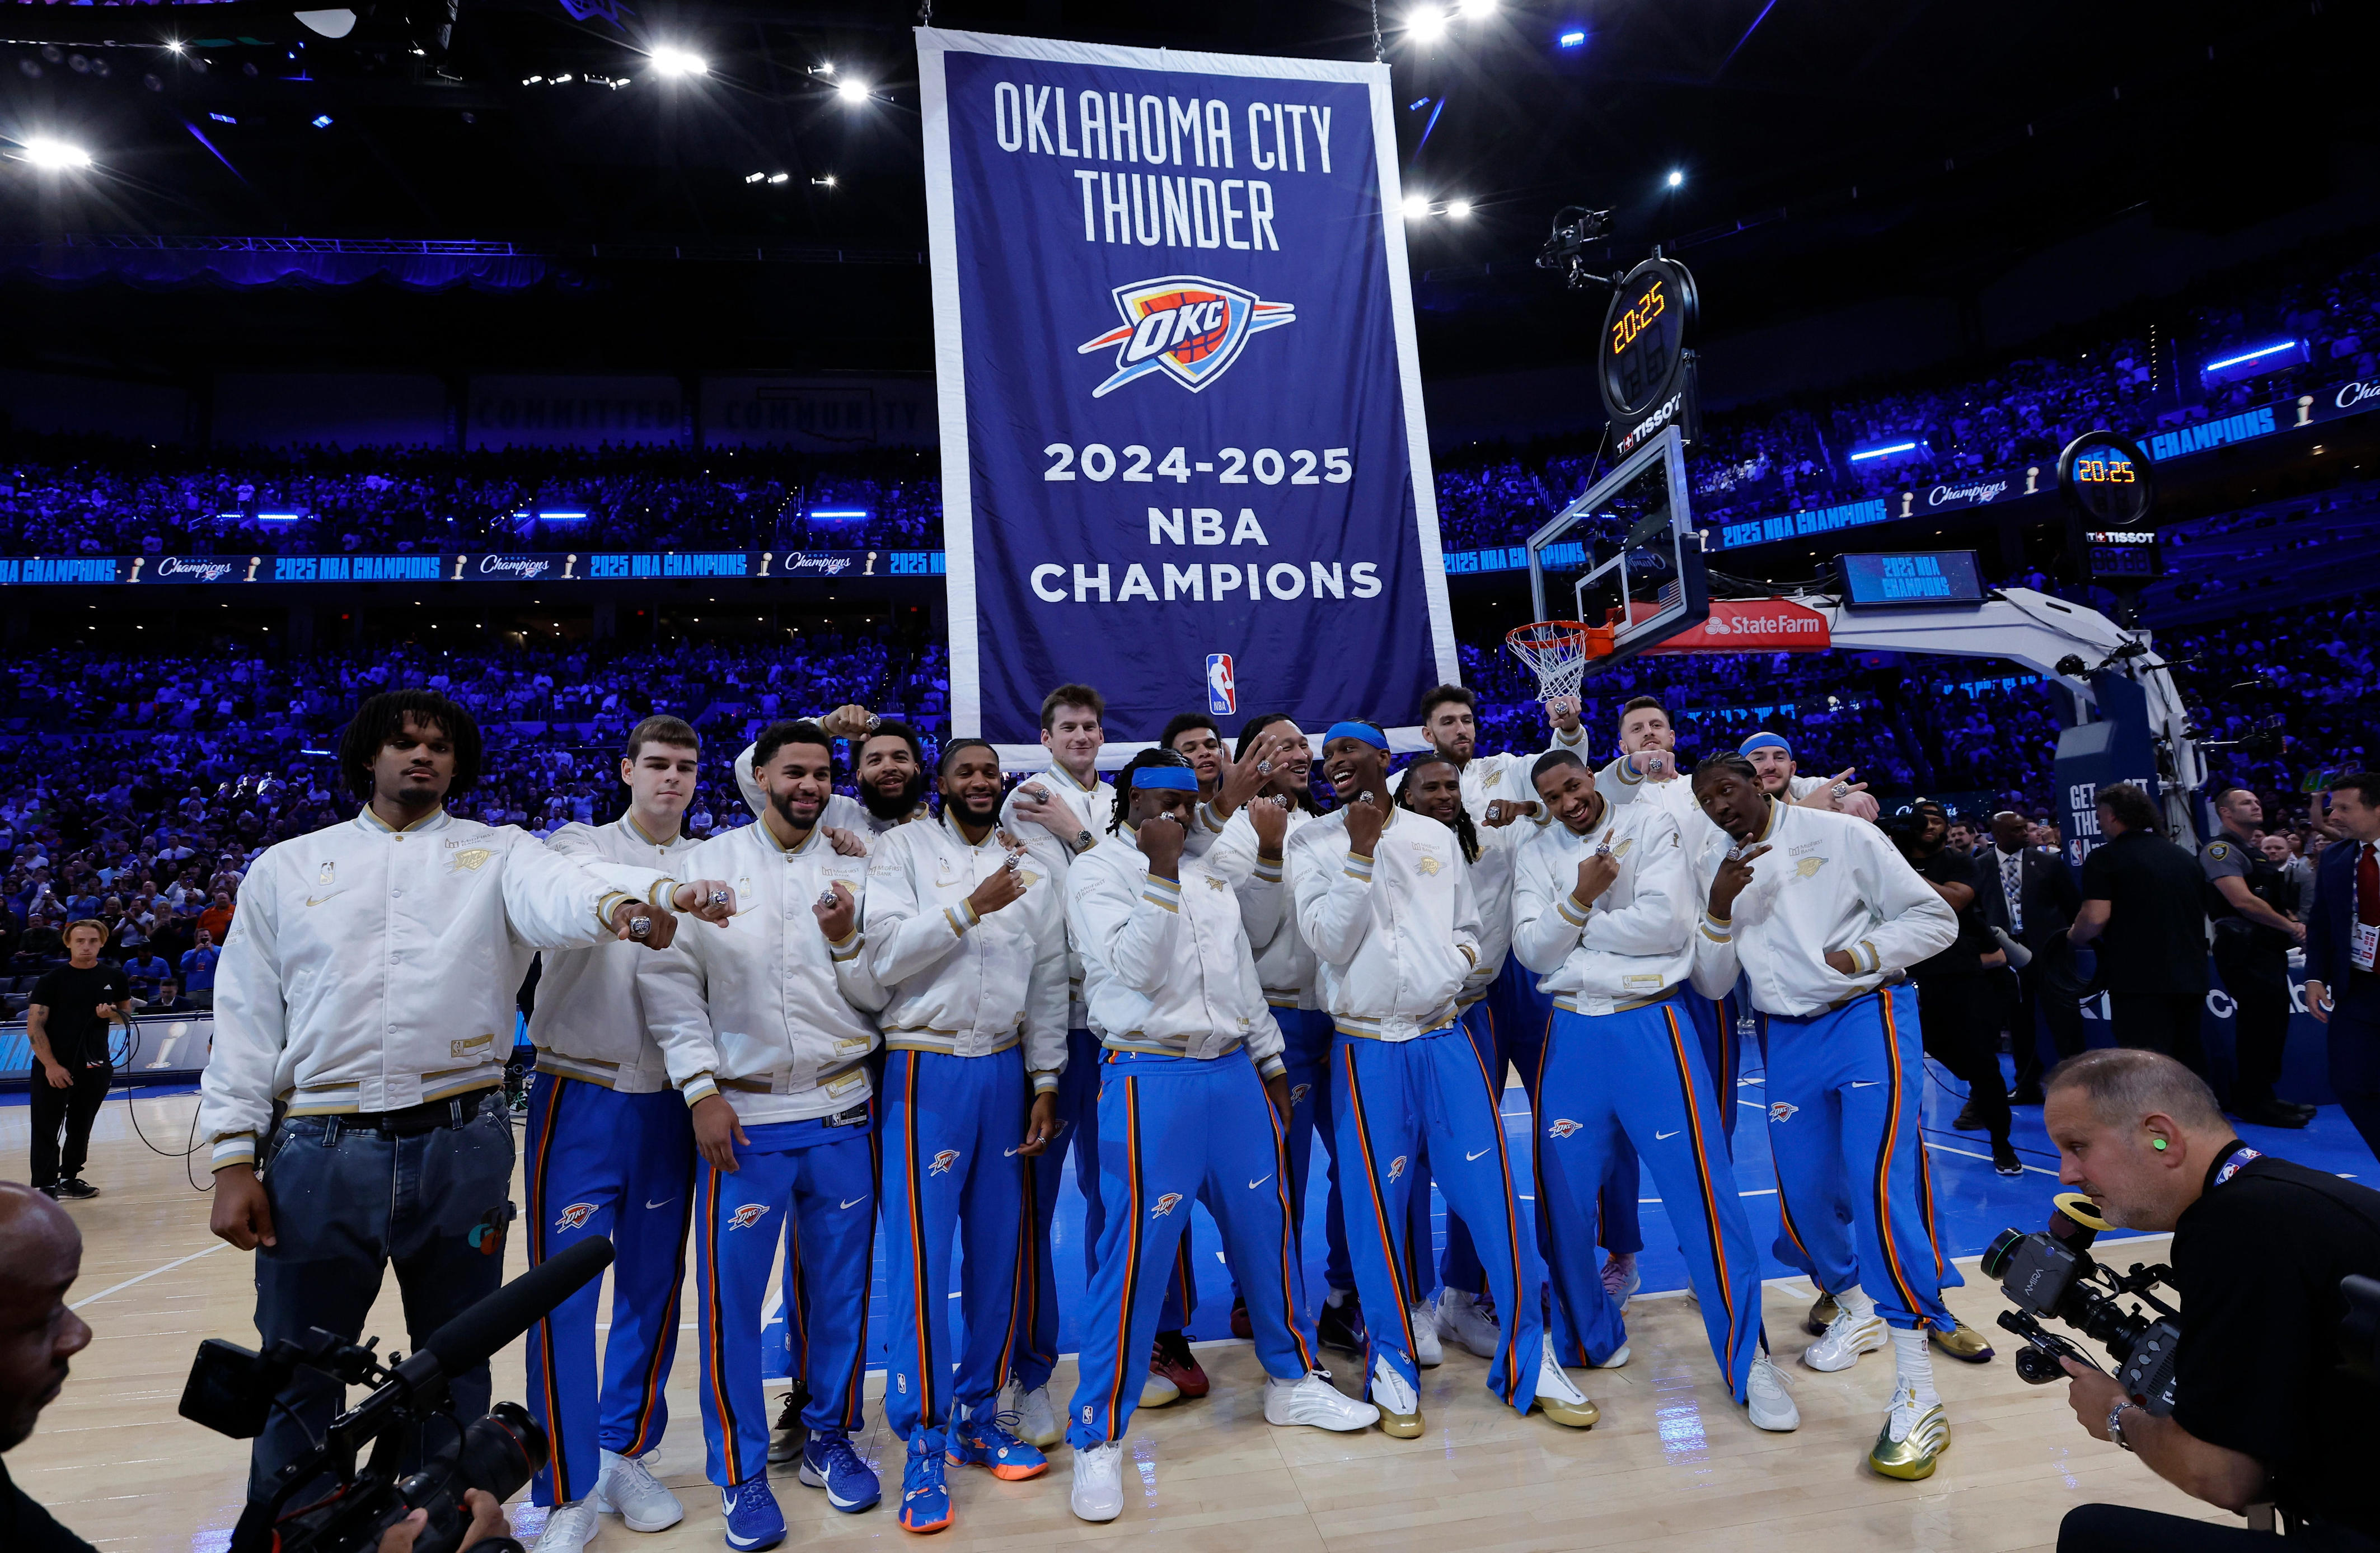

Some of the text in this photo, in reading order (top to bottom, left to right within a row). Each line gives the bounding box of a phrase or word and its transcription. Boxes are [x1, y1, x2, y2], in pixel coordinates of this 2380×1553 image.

[995, 81, 1332, 174] OKLAHOMA CITY
[1074, 170, 1280, 251] THUNDER
[1613, 280, 1665, 353] 20:25
[1127, 299, 1226, 359] OKC
[478, 399, 676, 428] COMMITTED
[1633, 392, 1682, 443] TISSOT
[2152, 407, 2276, 460] CHAMPIONS
[1044, 443, 1352, 485] 2024-2025
[2079, 460, 2135, 482] 20:25
[1928, 480, 2008, 506] Champions
[1149, 507, 1268, 545] NBA
[1722, 499, 1886, 547] 2025 NBA CHAMPIONS
[2105, 532, 2155, 543] TISSOT
[158, 557, 232, 576] Champions
[275, 557, 441, 579] 2025 NBA CHAMPIONS
[480, 555, 549, 575] Champions
[591, 554, 747, 577] 2025 NBA CHAMPIONS
[785, 552, 851, 572] Champions
[891, 553, 927, 573] 2025
[1480, 549, 1507, 570] NBA
[1882, 557, 1941, 577] 2025 NBA
[22, 560, 116, 582] CHAMPIONS
[1030, 562, 1382, 602] CHAMPIONS
[1882, 577, 1951, 597] CHAMPIONS
[1214, 701, 1226, 711] NBA
[2069, 783, 2096, 810] GET
[2072, 810, 2102, 836] THE
[1774, 1107, 1787, 1117] OKC
[1556, 1124, 1572, 1133] OKC
[936, 1154, 952, 1169] OKC
[1159, 1198, 1174, 1212] OKC
[565, 1208, 586, 1225] OKC
[737, 1209, 757, 1224] OKC
[2025, 1269, 2044, 1296] AMIRA
